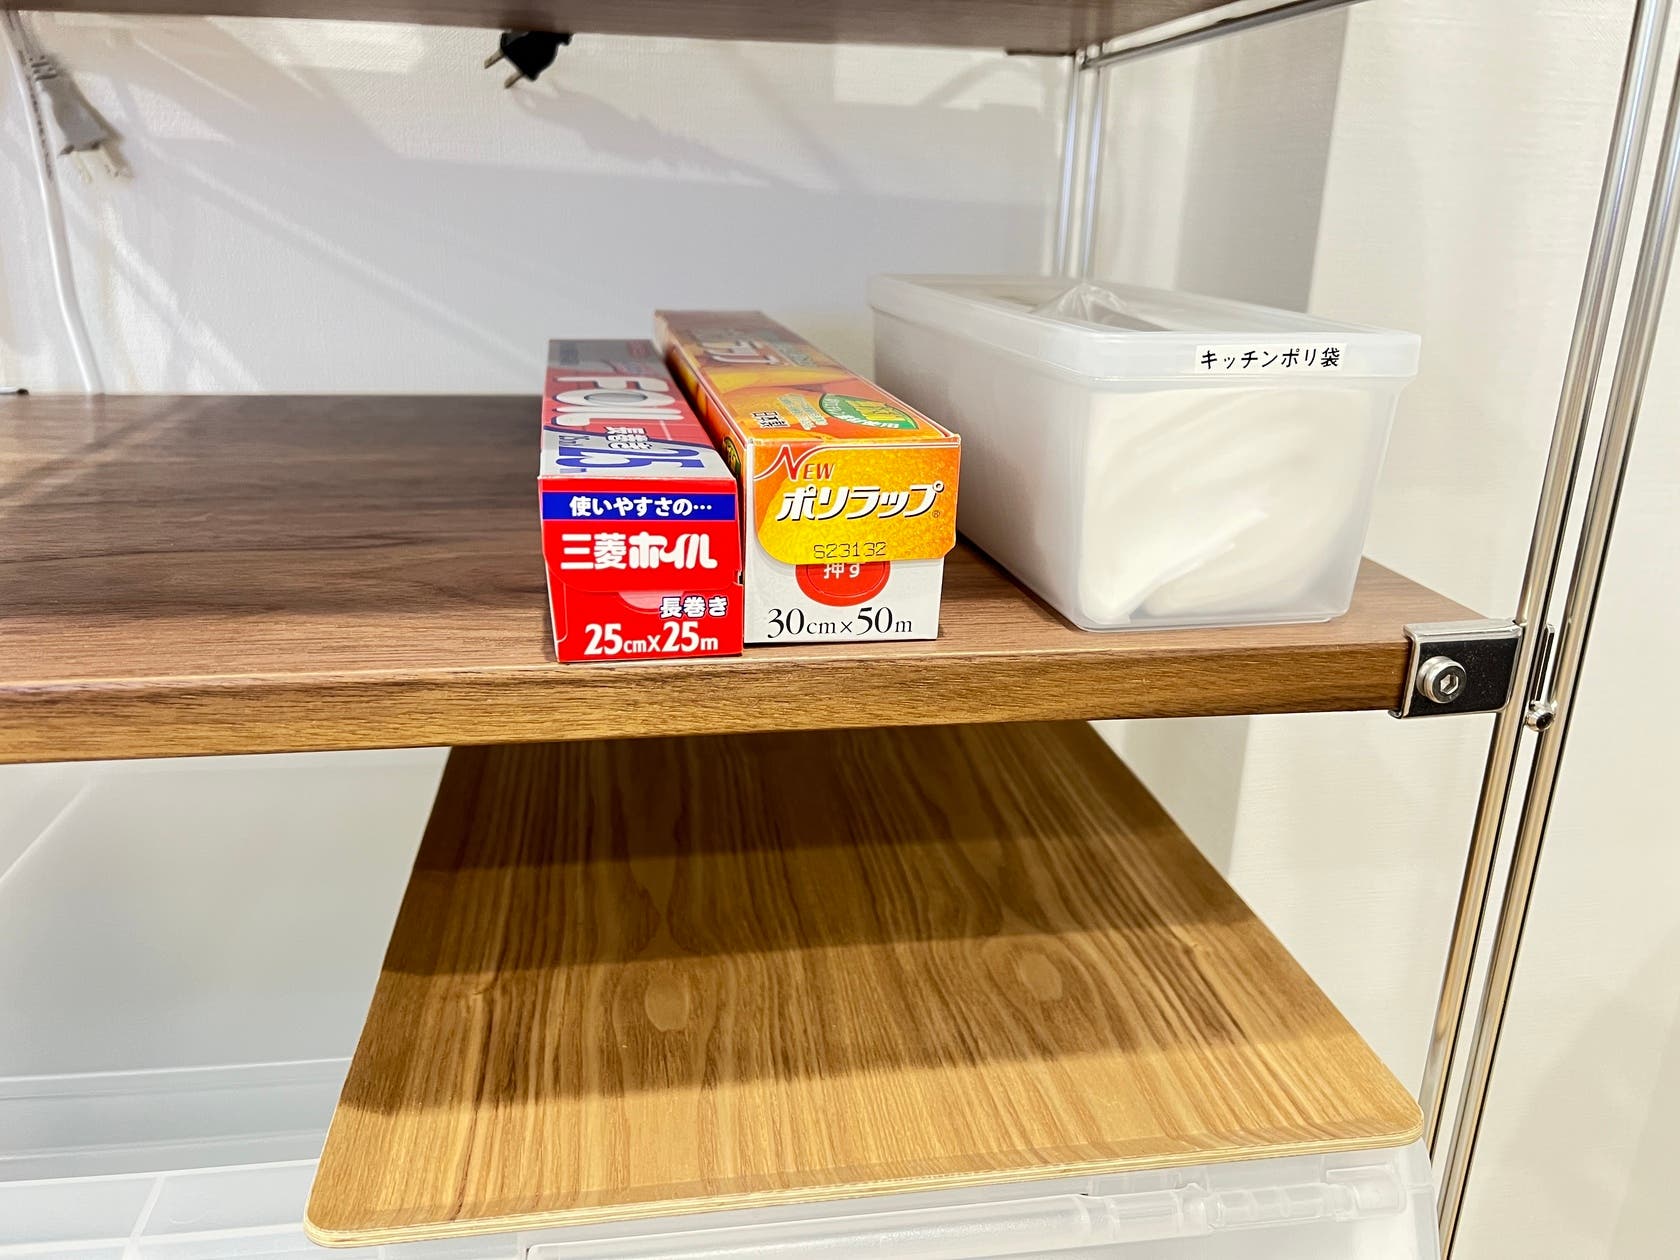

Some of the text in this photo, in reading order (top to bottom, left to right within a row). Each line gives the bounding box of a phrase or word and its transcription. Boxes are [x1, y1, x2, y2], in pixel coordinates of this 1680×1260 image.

[1200, 347, 1341, 371] キッチンポリ袋
[552, 376, 685, 427] FOIL
[604, 426, 653, 450] 長巻き
[766, 444, 835, 481] NEW
[776, 480, 945, 522] ポリラップ
[560, 531, 719, 570] 三菱ホイル
[659, 595, 729, 620] 長巻き
